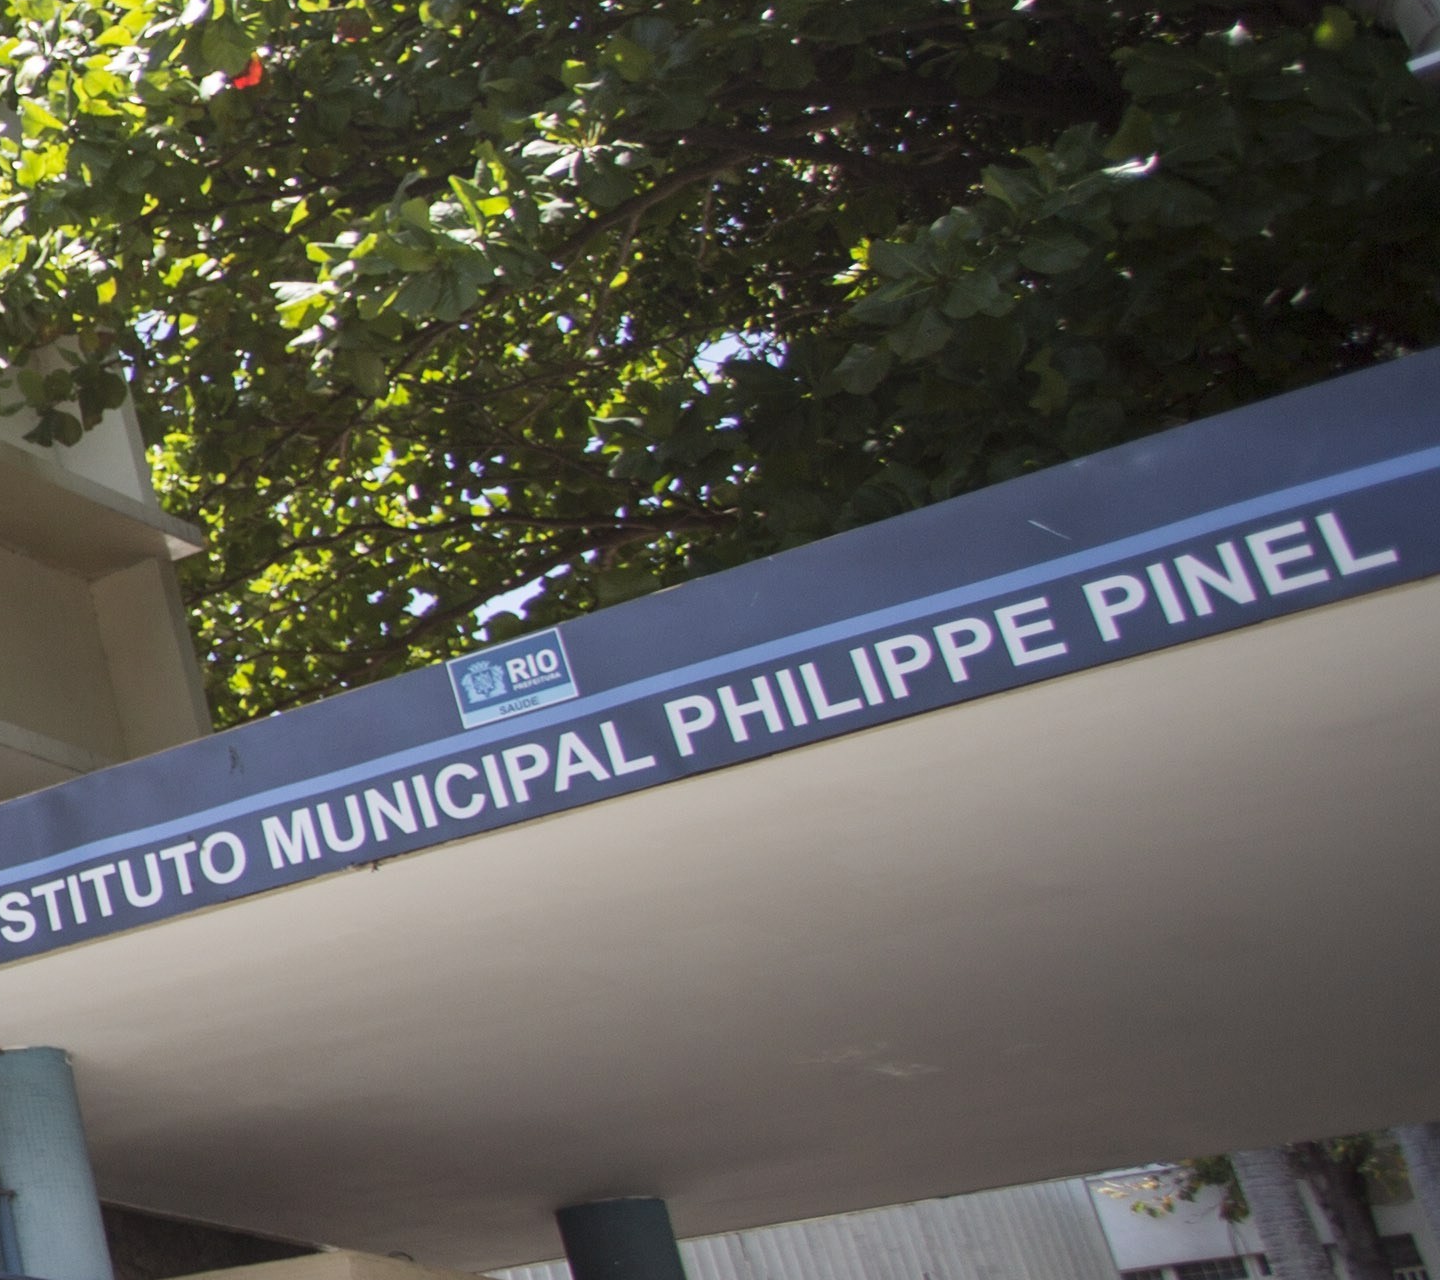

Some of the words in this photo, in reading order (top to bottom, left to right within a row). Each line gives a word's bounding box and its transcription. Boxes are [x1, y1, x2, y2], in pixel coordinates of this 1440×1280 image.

[261, 720, 655, 870] MUNICIPAL
[663, 596, 1067, 757] PHILIPPE
[1082, 512, 1398, 642] PINEL
[505, 648, 559, 684] RIO
